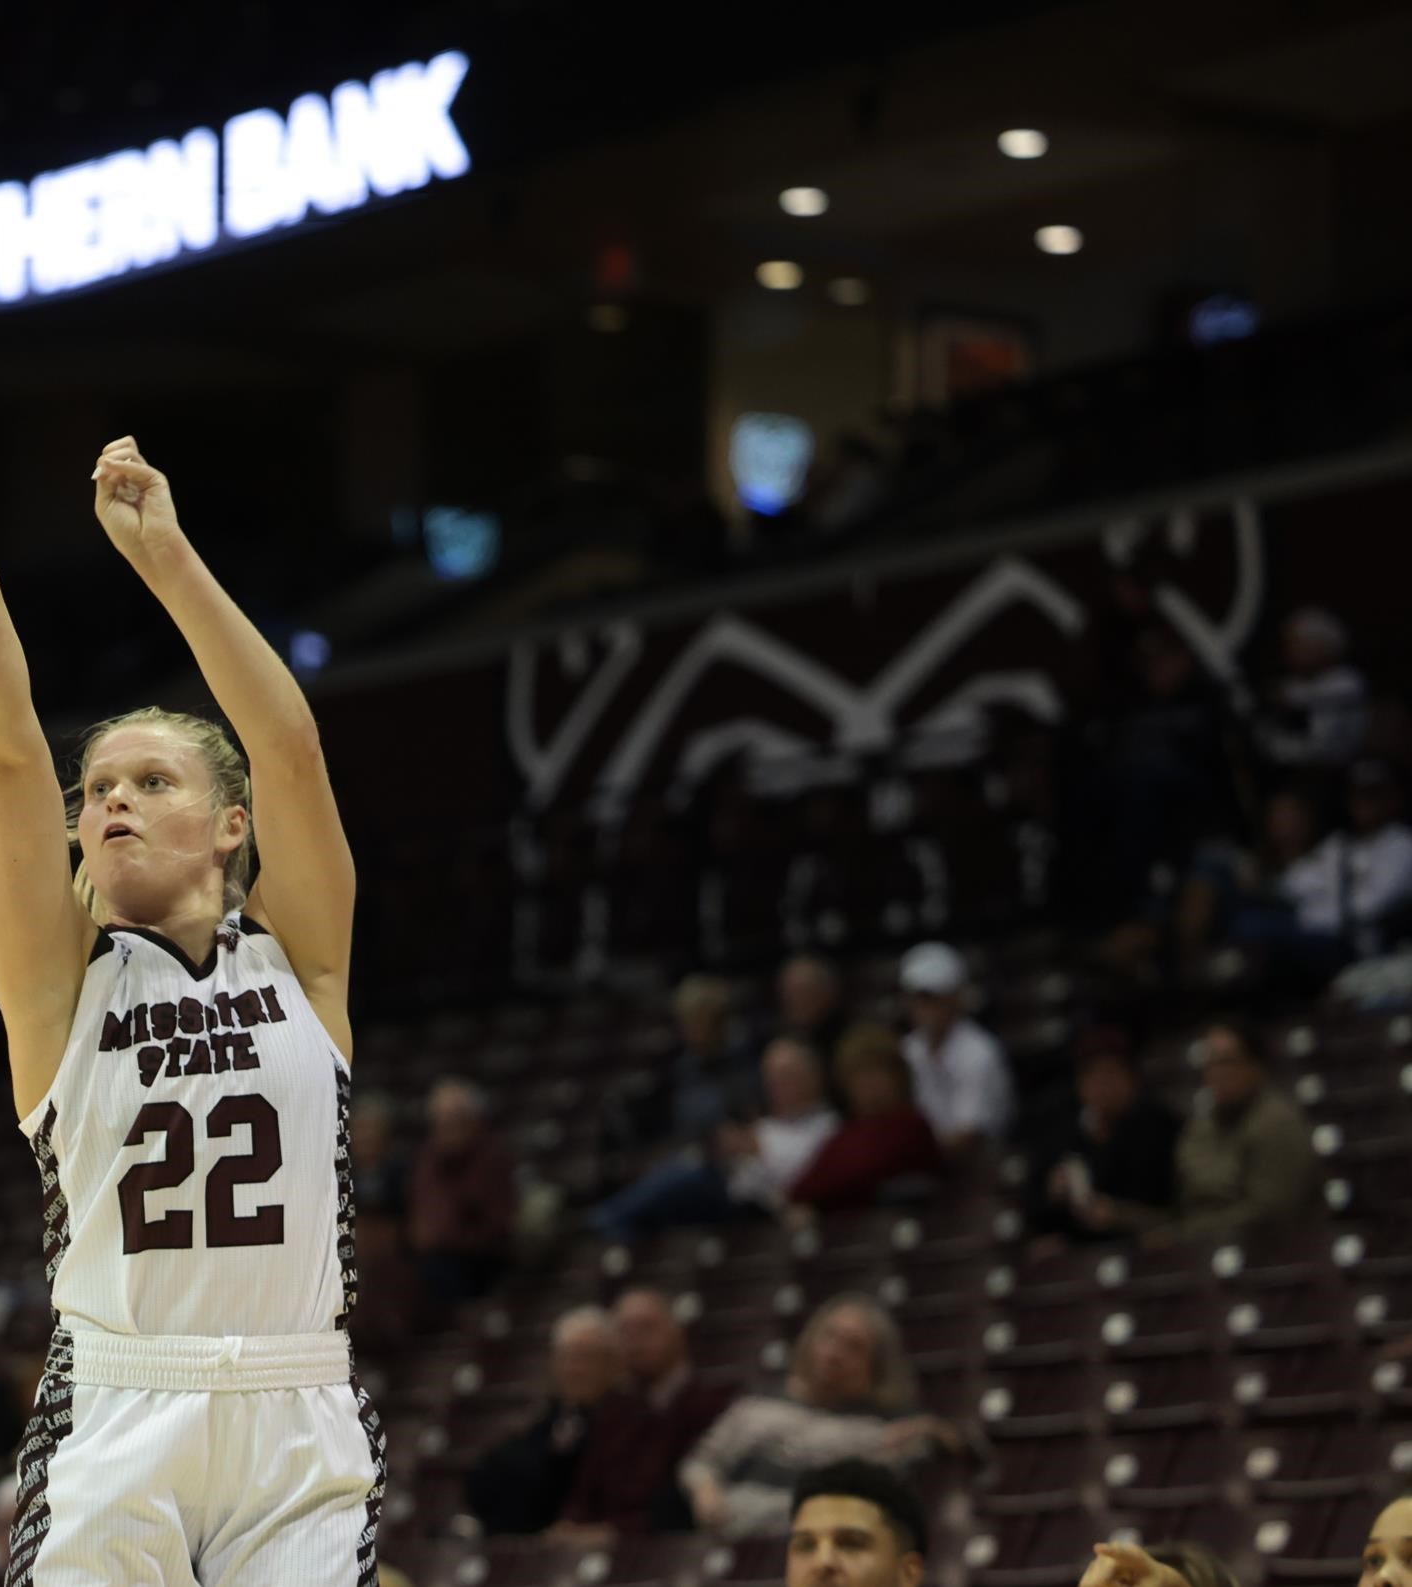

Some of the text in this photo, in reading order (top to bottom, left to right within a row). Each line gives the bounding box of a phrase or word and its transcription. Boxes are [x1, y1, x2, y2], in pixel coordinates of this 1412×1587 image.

[223, 48, 472, 238] BANK
[137, 1031, 260, 1087] STATE
[117, 1093, 285, 1255] 22
